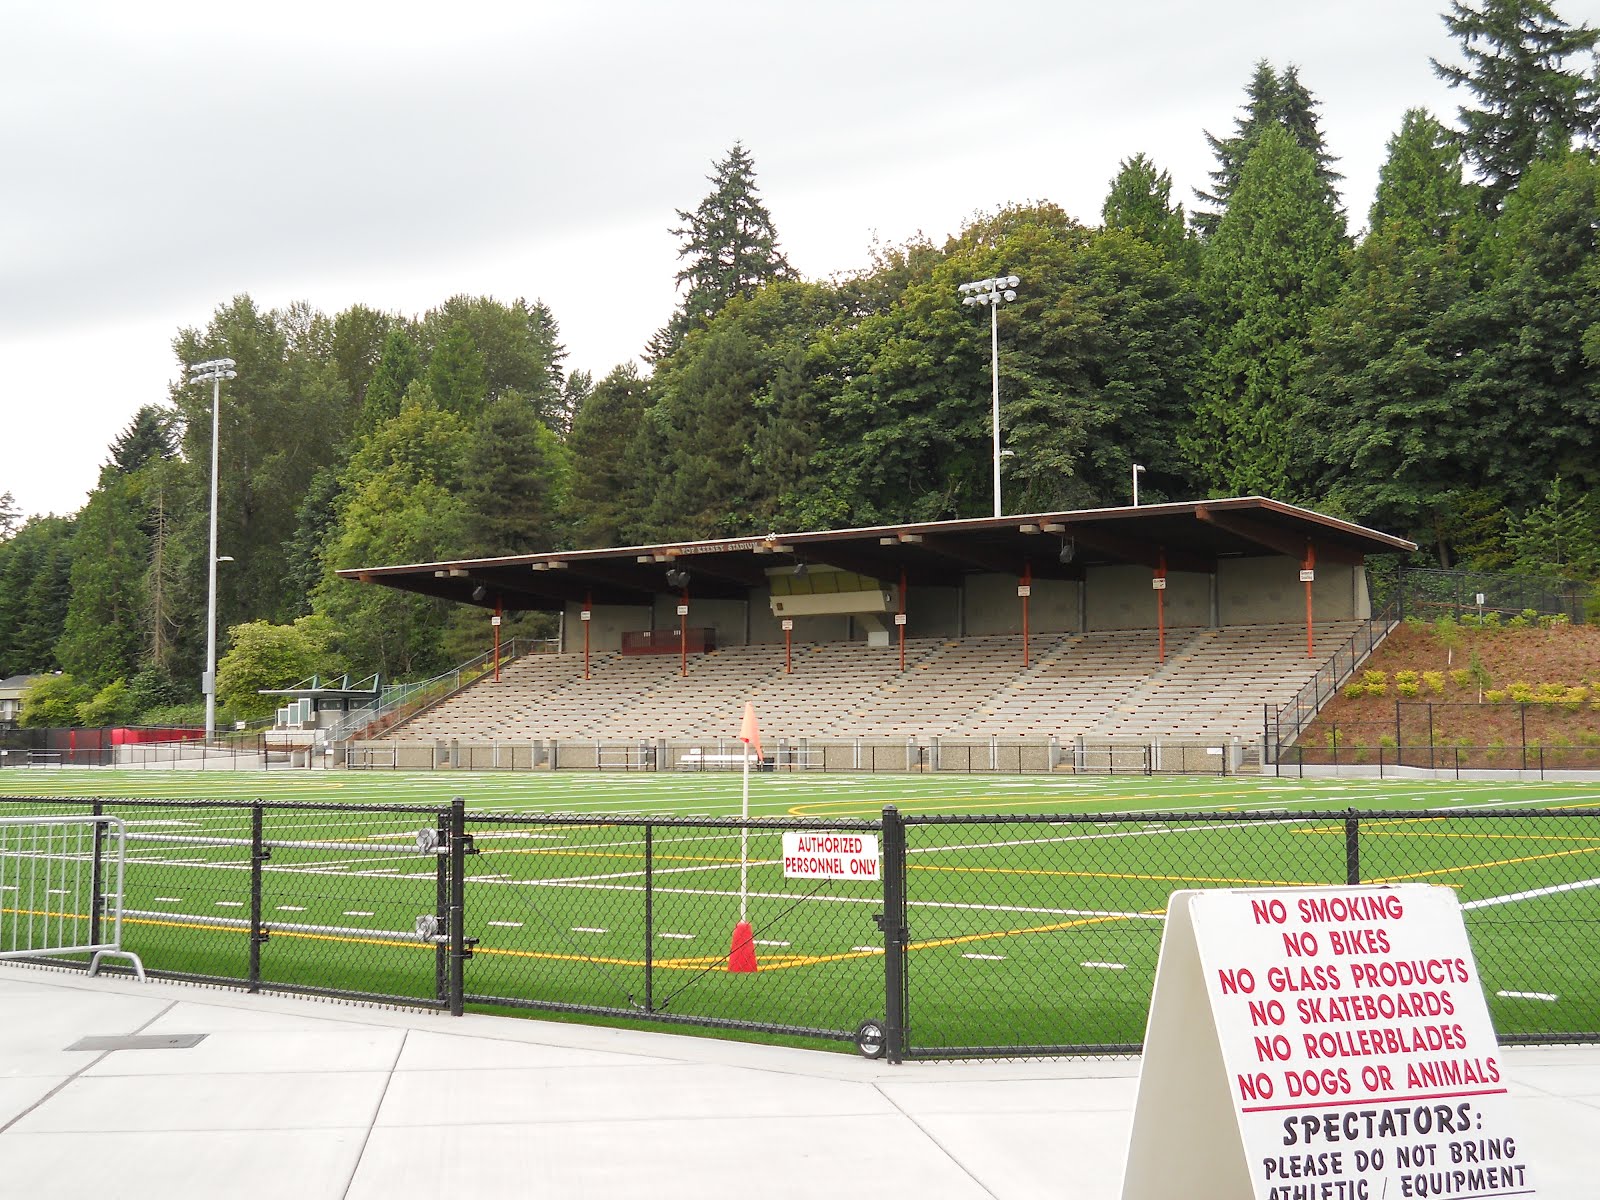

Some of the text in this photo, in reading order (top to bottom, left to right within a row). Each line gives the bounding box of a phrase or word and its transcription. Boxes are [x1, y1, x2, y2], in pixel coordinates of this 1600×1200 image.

[798, 837, 863, 853] AUTHORIZED
[785, 857, 876, 875] PERSONNEL ONLY
[1252, 895, 1403, 925] NO SMOKING
[1283, 929, 1391, 957] NO BIKES
[1219, 958, 1469, 995] NO GLASS PRODUCTS
[1249, 990, 1455, 1026] NO SKATEBOARDS
[1255, 1023, 1467, 1062] NO ROLLERBLADES
[1237, 1057, 1501, 1101] NO DOGS OR ANIMALS
[1283, 1103, 1482, 1146] SPECTATORS:
[1263, 1137, 1516, 1180] PLEASE DO NOT BRING
[1268, 1178, 1369, 1200] ATHLETIC
[1401, 1164, 1526, 1198] EQUIPMENT
